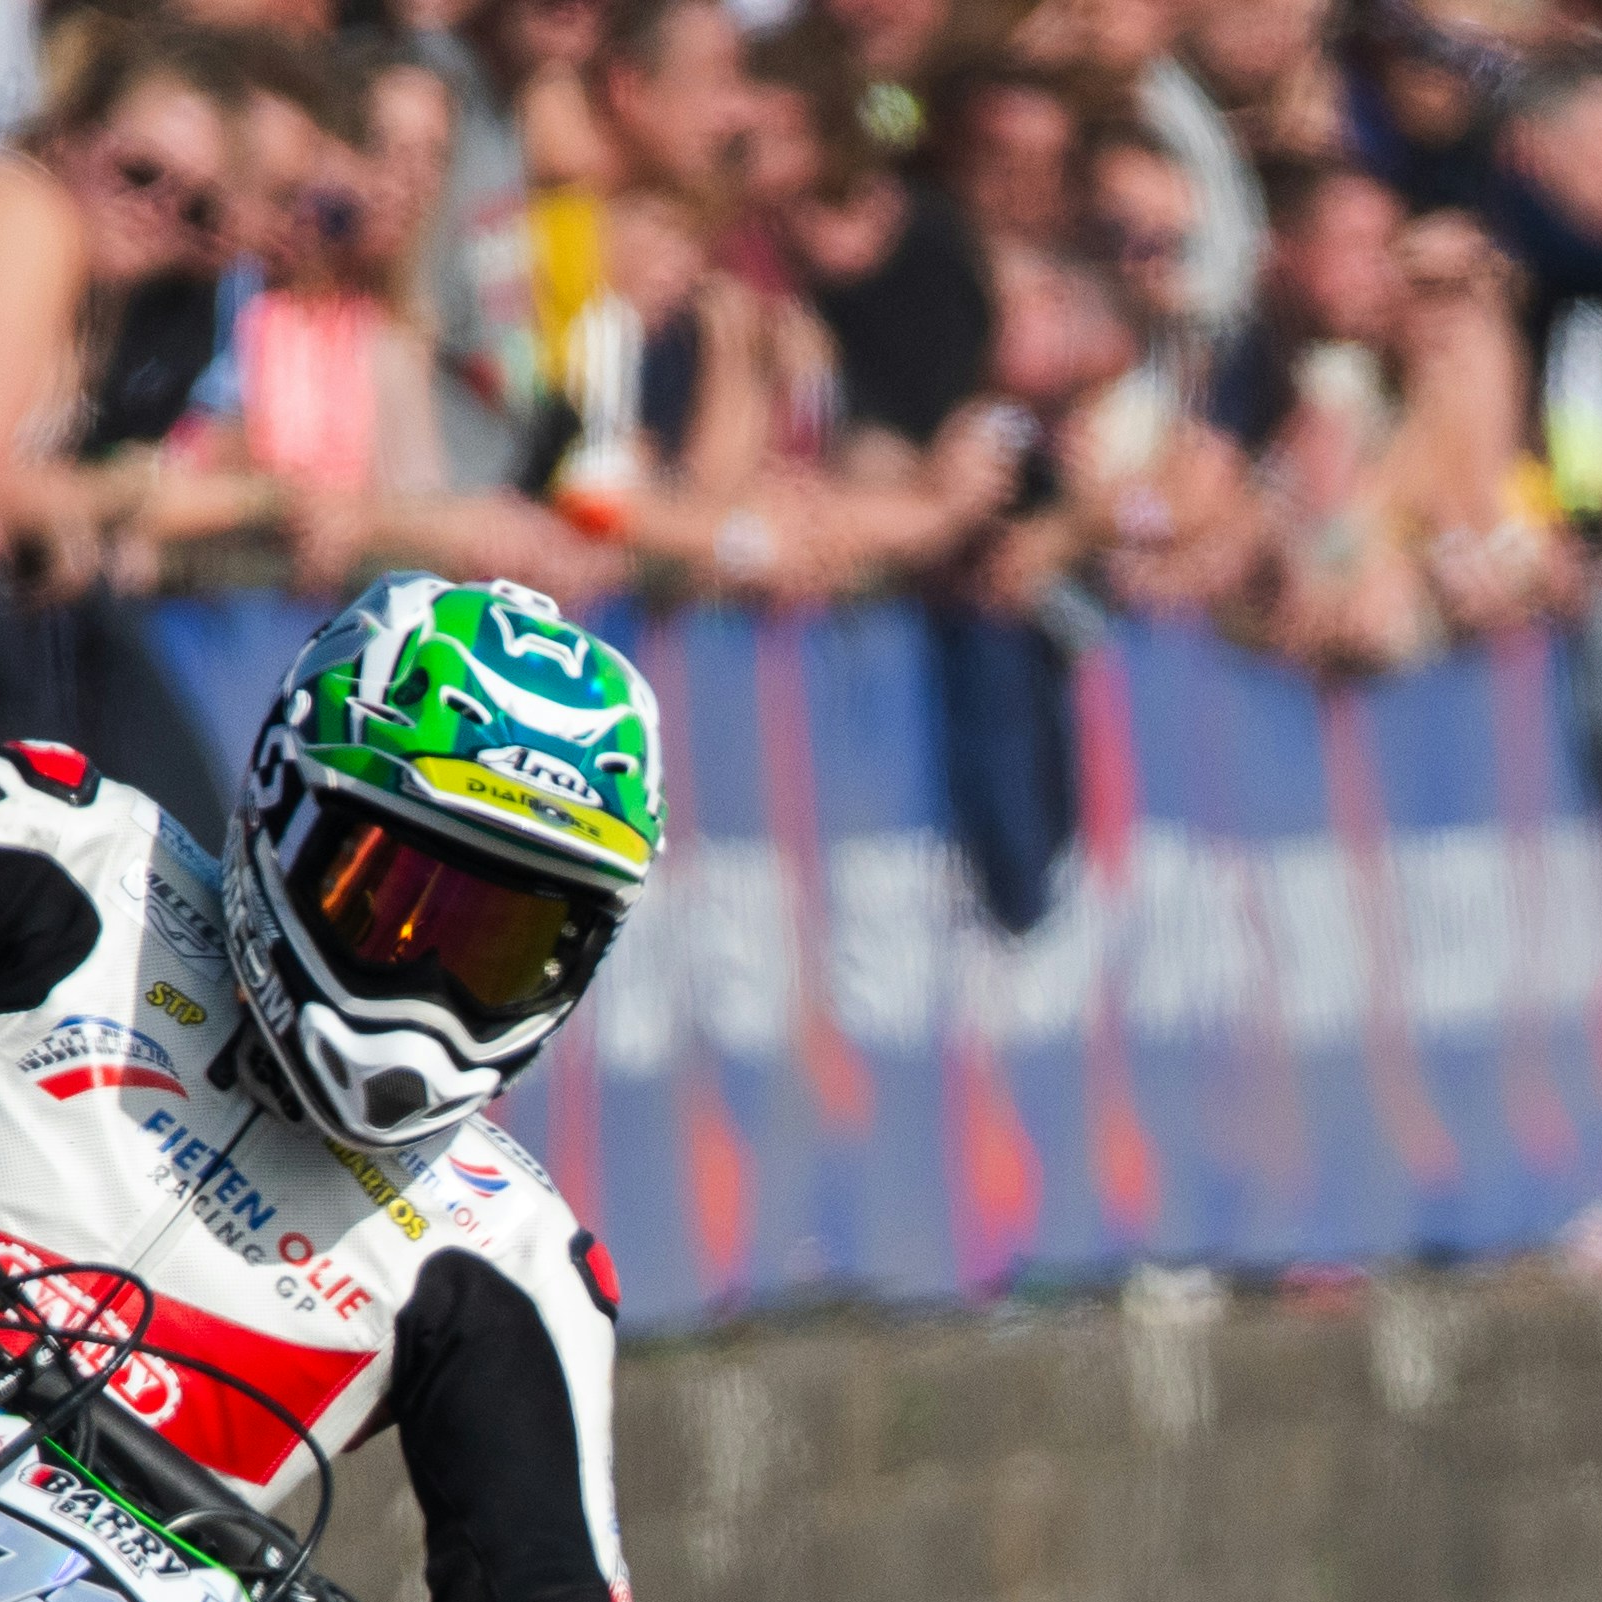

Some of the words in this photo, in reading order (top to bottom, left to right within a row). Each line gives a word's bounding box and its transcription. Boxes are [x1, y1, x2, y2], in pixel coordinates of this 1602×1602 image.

[493, 746, 590, 799] Arai
[146, 981, 207, 1025] STP
[142, 1108, 278, 1231] FIETEN
[277, 1231, 374, 1321] OLIE
[147, 1164, 267, 1265] RACING
[275, 1275, 317, 1312] GP
[44, 1469, 187, 1576] BARRY
[57, 1499, 148, 1569] BALTUS
